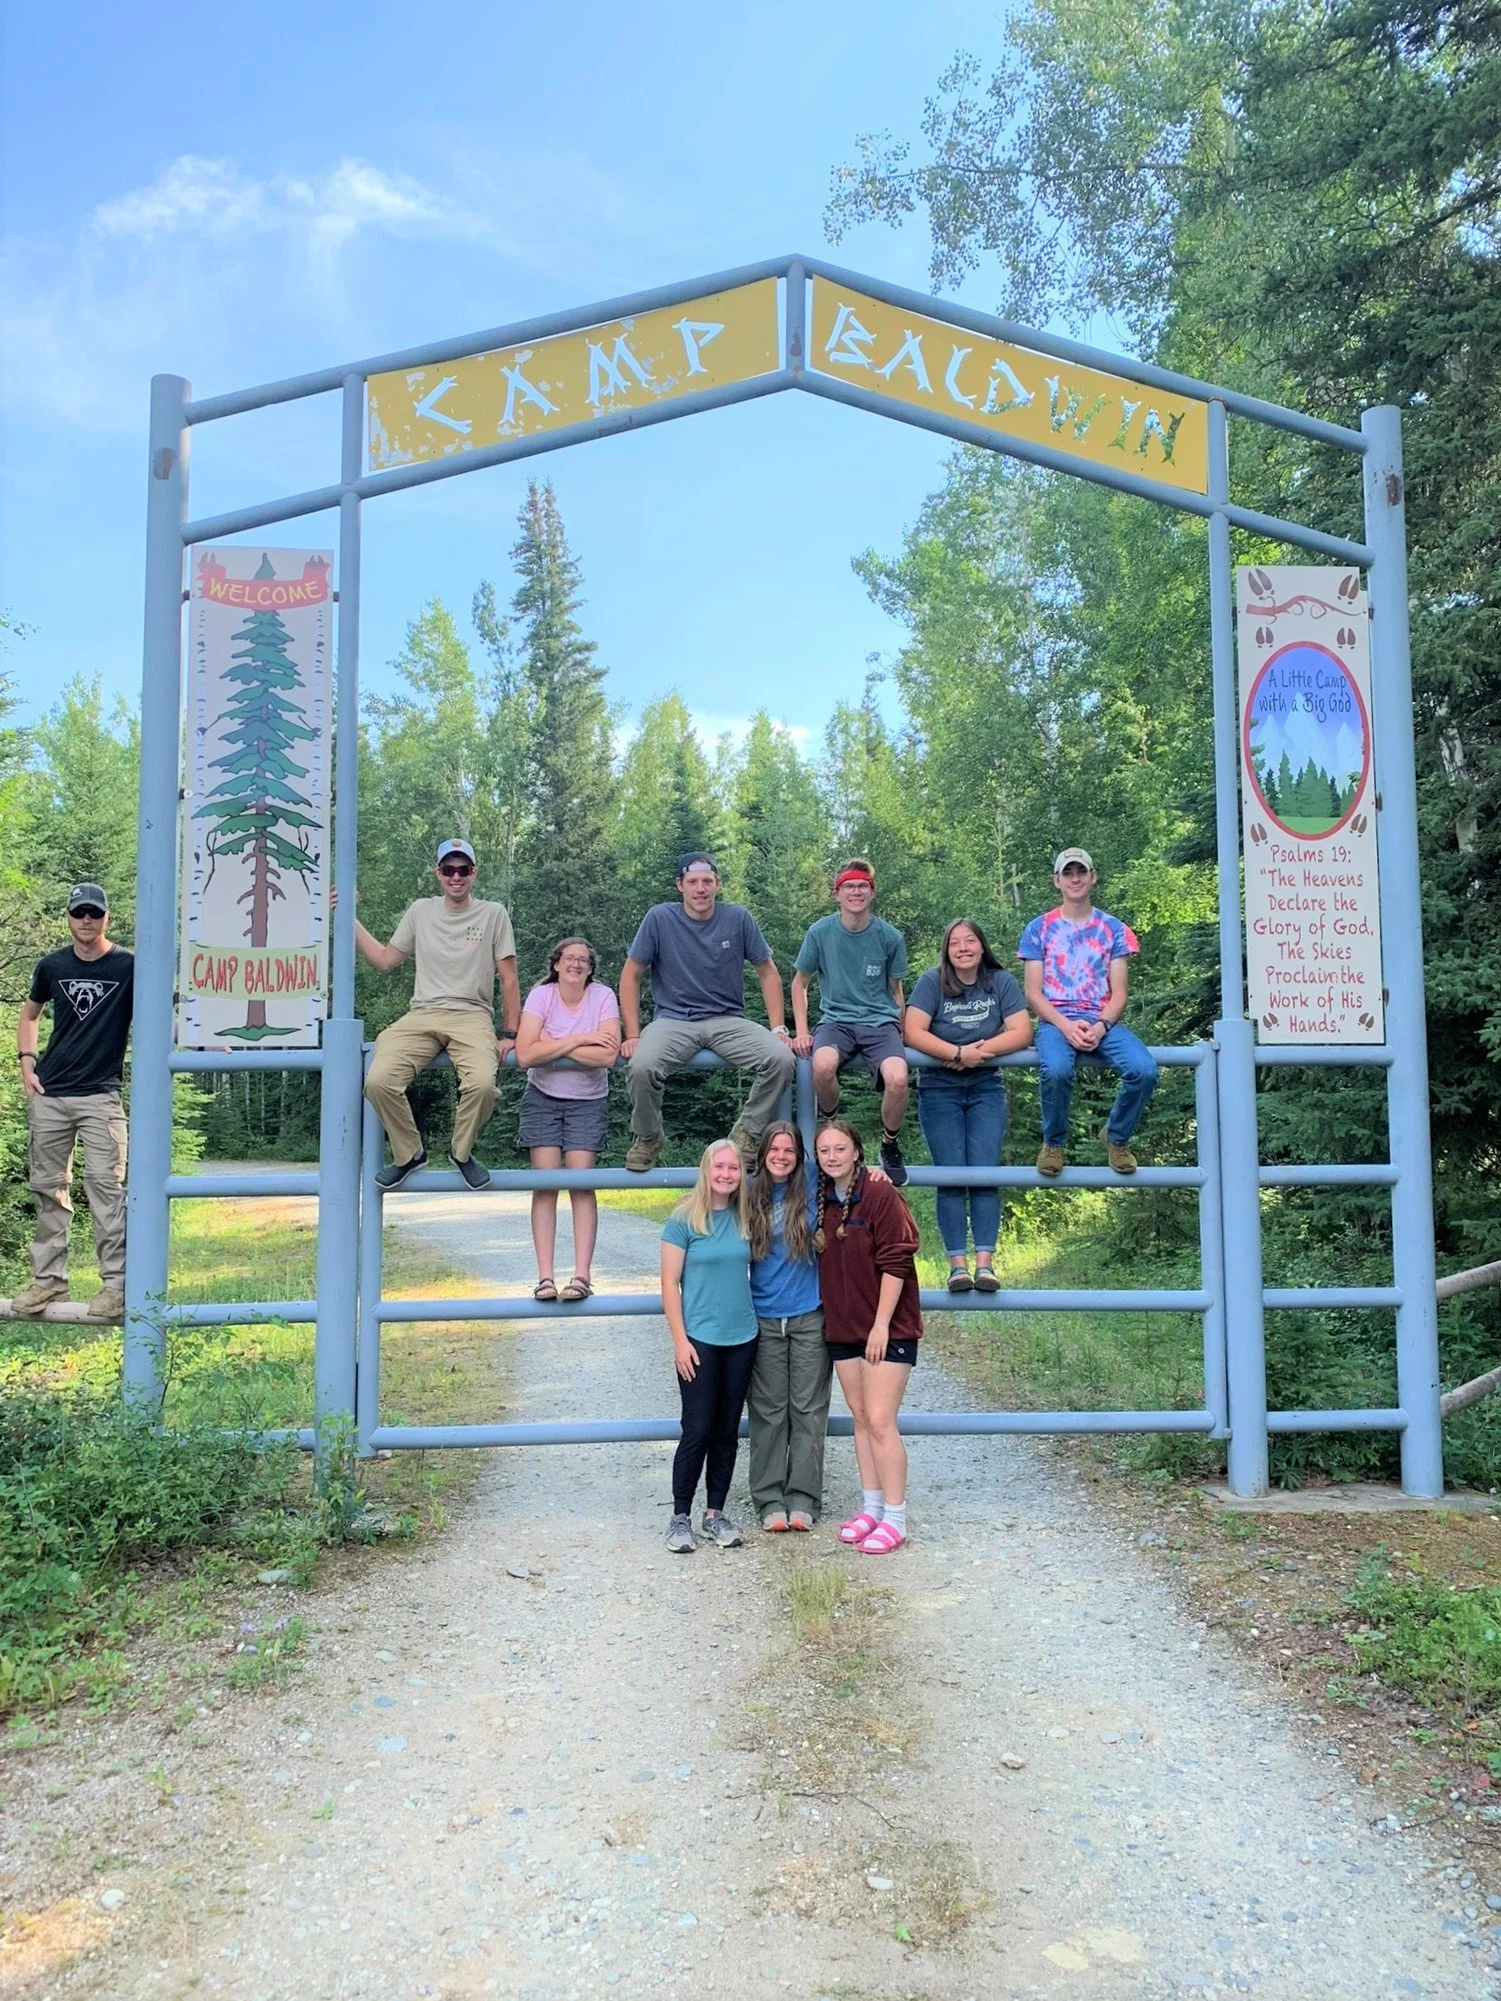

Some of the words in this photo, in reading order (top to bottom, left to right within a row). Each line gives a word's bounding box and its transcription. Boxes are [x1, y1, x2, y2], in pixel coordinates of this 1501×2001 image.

[414, 316, 725, 434] CAMP
[824, 302, 1186, 466] BALDWIN
[208, 576, 322, 606] WELCOME
[1268, 670, 1278, 688] A
[1281, 670, 1313, 688] Little
[1316, 671, 1347, 696] Camp
[1259, 692, 1288, 713] with
[1291, 699, 1299, 713] a
[1303, 692, 1327, 722] Big
[1329, 693, 1352, 713] God
[1270, 844, 1324, 862] Psalms
[1331, 845, 1351, 862] 19:
[1260, 868, 1296, 887] "The
[1303, 869, 1364, 887] Heavens
[1268, 893, 1327, 911] Declare
[1334, 892, 1358, 911] the
[1253, 917, 1301, 946] Glory
[1308, 913, 1325, 939] of
[1277, 941, 1304, 959] The
[1313, 942, 1352, 960] Skies
[192, 953, 238, 994] CAMP
[244, 953, 318, 994] BALDWIN
[1265, 966, 1338, 984] Proclaim
[1340, 965, 1365, 984] the
[1269, 989, 1309, 1009] Work
[1317, 986, 1334, 1013] of
[1341, 991, 1362, 1008] His
